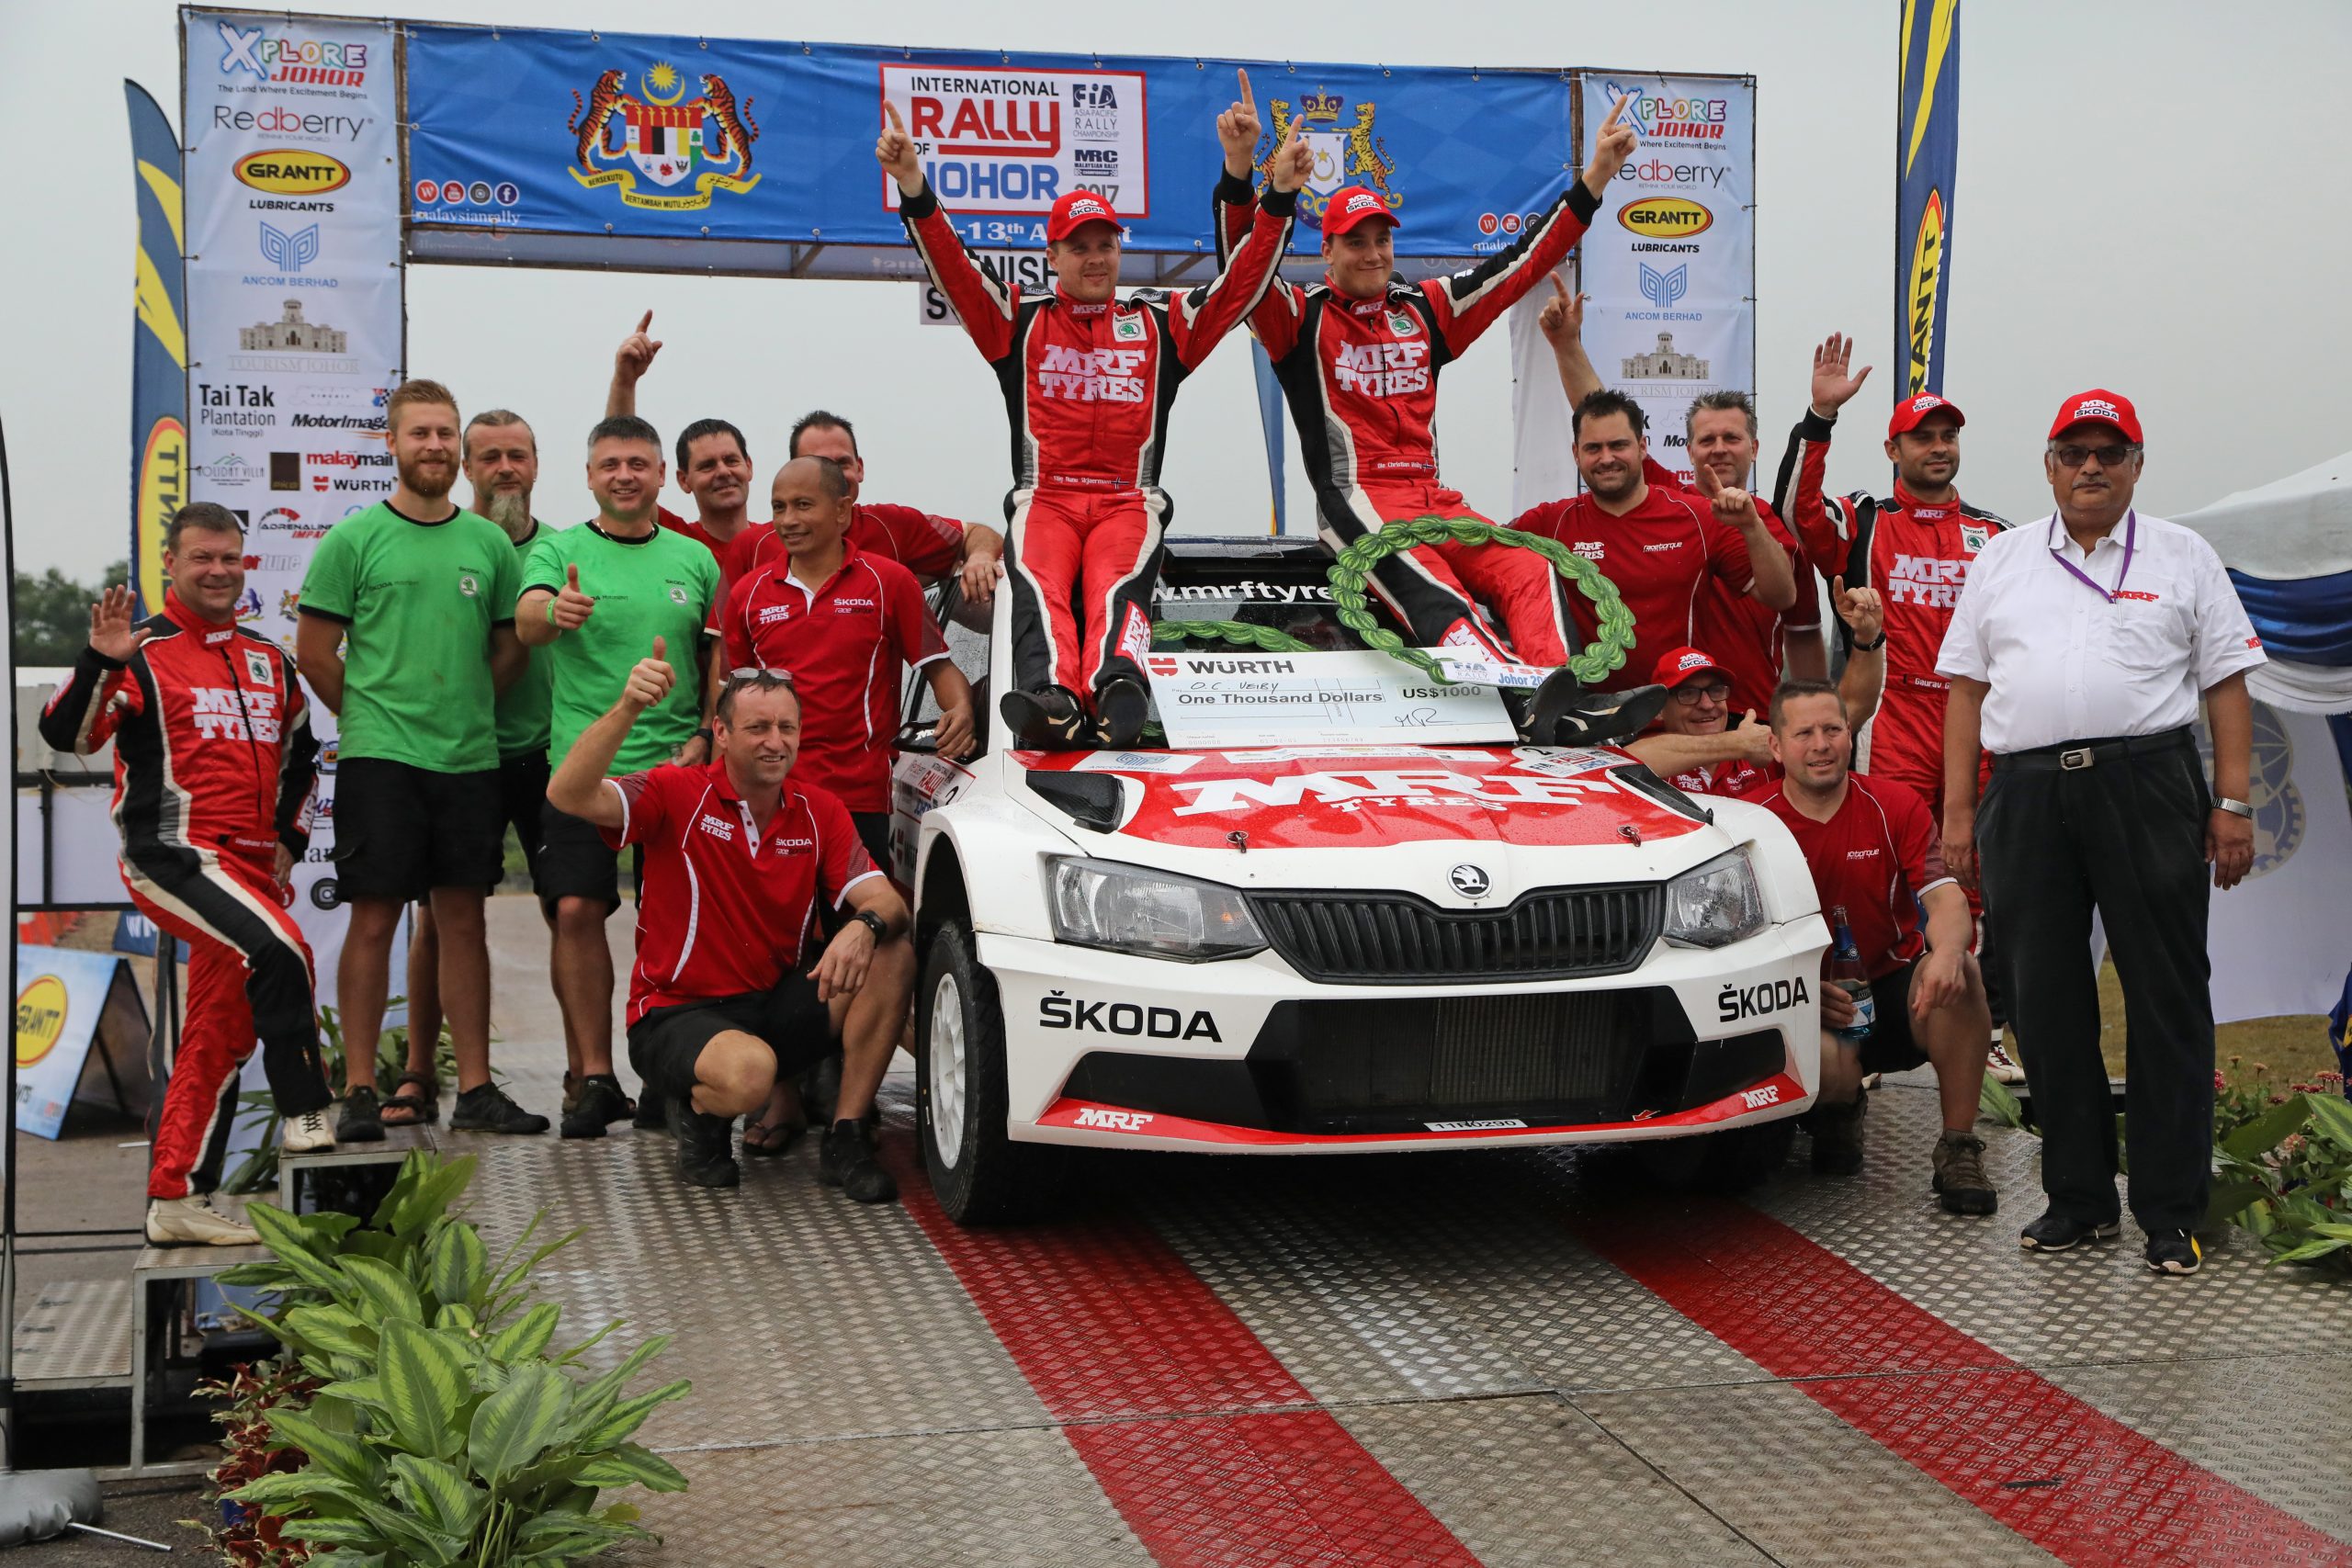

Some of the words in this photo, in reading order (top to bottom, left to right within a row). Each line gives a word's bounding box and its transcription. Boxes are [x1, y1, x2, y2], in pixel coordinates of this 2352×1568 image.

[271, 65, 365, 88] JOHOR
[218, 85, 233, 94] The
[236, 85, 257, 94] Land
[259, 85, 288, 95] Where
[289, 87, 337, 97] Excitement
[339, 90, 368, 100] Begins
[911, 76, 1059, 96] INTERNATIONAL
[214, 106, 365, 141] Redberry
[1075, 118, 1118, 130] RALLY
[1648, 122, 1724, 140] JOHOR
[1639, 141, 1662, 149] Where
[1664, 141, 1702, 150] Excitement
[1703, 141, 1726, 151] Begins
[1074, 149, 1118, 164] MRC
[246, 163, 336, 182] GRANTT
[1612, 159, 1724, 188] edberry
[249, 199, 335, 212] LUBRICANTS
[1629, 209, 1702, 226] GRANTT
[1631, 243, 1700, 254] LUBRICANTS
[242, 276, 287, 287] ANCOM
[288, 276, 339, 288] BERHAD
[1072, 304, 1107, 314] MRF
[1354, 300, 1384, 315] MRF
[1624, 311, 1660, 321] ANCOM
[1662, 312, 1702, 321] BERHAD
[1909, 230, 1936, 399] RANTT
[1039, 344, 1147, 376] MRF
[1335, 340, 1429, 372] MRF
[1038, 371, 1146, 403] TYRES
[1335, 367, 1429, 398] TYRES
[198, 384, 231, 407] Tai
[235, 385, 276, 407] Tak
[2080, 399, 2116, 411] MRF
[200, 409, 277, 427] Plantation
[307, 450, 393, 469] malaymail
[334, 479, 392, 491] WÜRTH
[1914, 508, 1949, 519] MRF
[833, 597, 874, 606] ŠKODA
[759, 604, 789, 617] MRF
[759, 613, 789, 625] TYRES
[205, 630, 235, 644] MRF
[1187, 660, 1295, 674] WÜRTH
[1501, 665, 1545, 676] 1st
[1498, 673, 1528, 685] Johor
[1178, 694, 1216, 705] One
[1221, 693, 1313, 705] Thousand
[1319, 692, 1383, 703] Dollars
[1403, 686, 1482, 699] US$1000
[190, 687, 277, 717] MRF
[194, 712, 280, 743] TYRES
[1727, 768, 1756, 784] ŠKODA
[1172, 771, 1620, 817] MRF
[1329, 795, 1510, 813] TYRES
[704, 814, 734, 831] MRF
[700, 822, 732, 841] TYRES
[775, 836, 812, 847] ŠKODA
[1717, 976, 1810, 1023] ŠKODA
[1039, 990, 1224, 1043] ŠKODA
[1740, 1085, 1780, 1109] MRF
[1074, 1108, 1154, 1133] MRF
